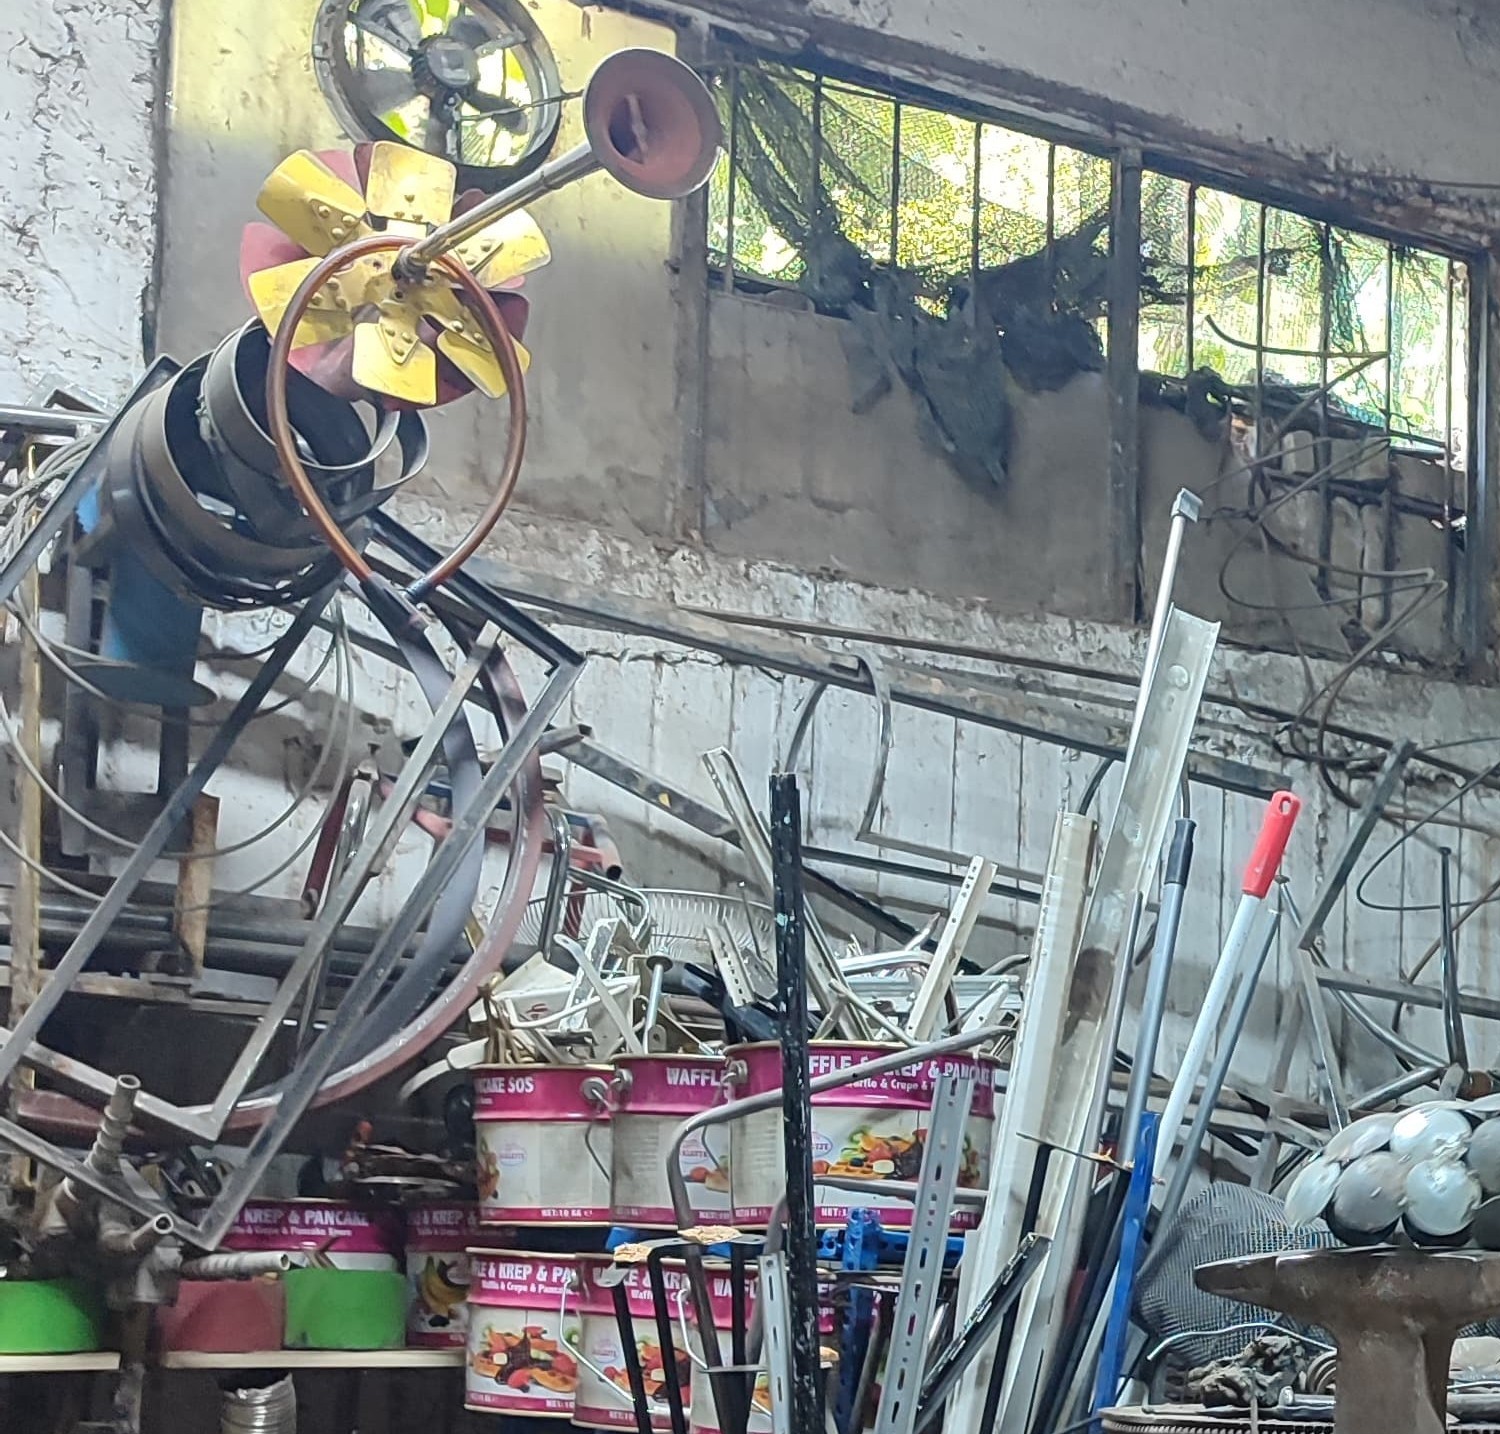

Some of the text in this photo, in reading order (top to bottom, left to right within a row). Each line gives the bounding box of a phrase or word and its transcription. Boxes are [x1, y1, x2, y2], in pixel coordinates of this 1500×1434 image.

[809, 1055, 853, 1075] FFLE
[507, 1075, 535, 1094] SOS
[890, 1080, 919, 1092] Crepe
[304, 1209, 369, 1227] PANCAKE
[498, 1262, 532, 1281] KREP
